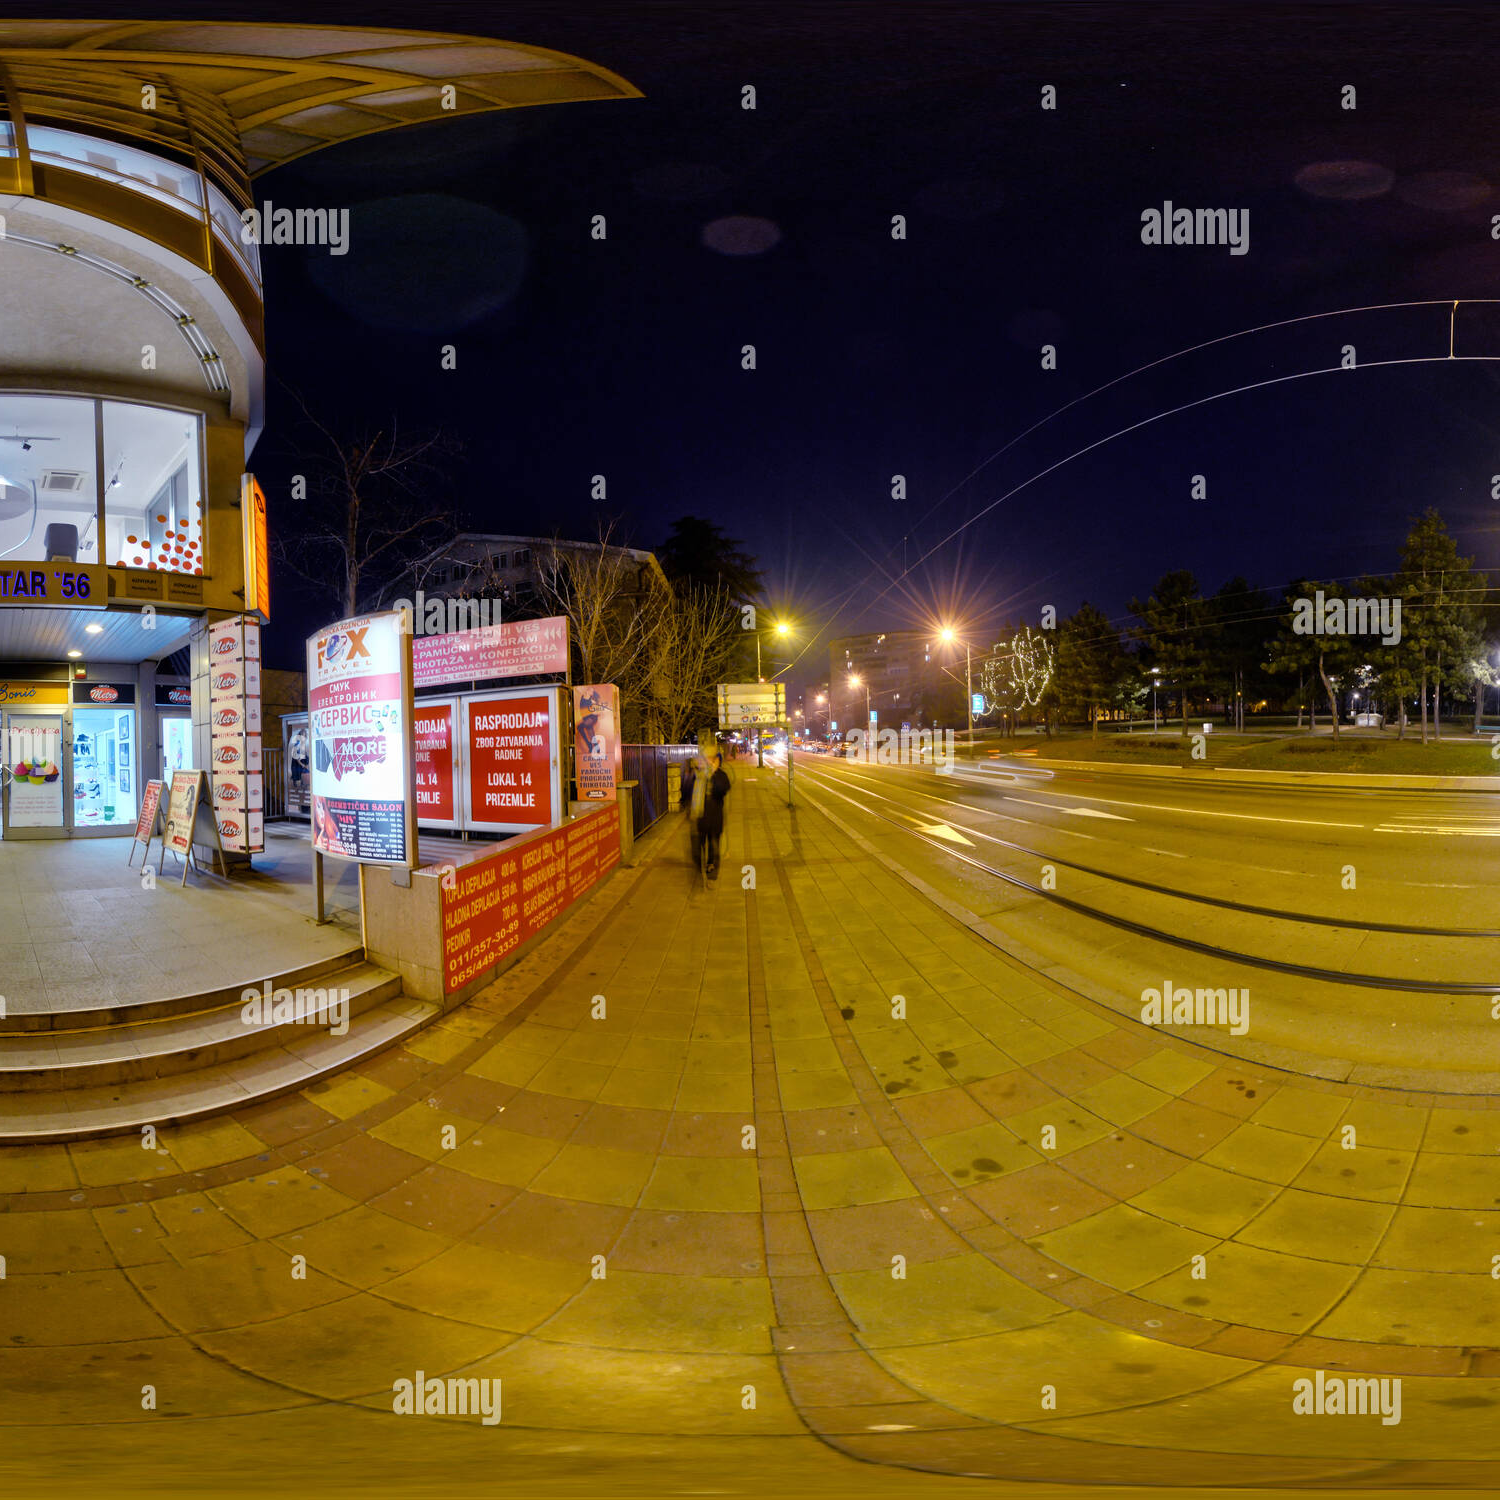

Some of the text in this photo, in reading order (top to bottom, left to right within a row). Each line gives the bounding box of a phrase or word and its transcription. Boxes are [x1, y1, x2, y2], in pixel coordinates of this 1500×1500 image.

[417, 634, 461, 650] ČARAPE
[516, 623, 541, 634] VEŠ
[212, 637, 238, 655] Metro
[419, 635, 539, 659] PAMUČNI PROGRAM
[413, 643, 558, 670] RIKOTAŽA KONFEKCIJA
[318, 660, 372, 677] TRAVEL
[213, 674, 239, 691] Metro
[330, 681, 350, 694] СМУК
[90, 689, 118, 700] Metro
[213, 711, 240, 727] Metro
[321, 705, 374, 728] СЕРВИС
[475, 712, 543, 731] RASPRODAJA
[12, 726, 60, 737] Principessa
[341, 739, 387, 755] MORE
[475, 734, 543, 748] ZBOG ZATVARANJA
[214, 748, 240, 764] Metro
[495, 749, 523, 760] RADNJE
[428, 772, 438, 785] 14
[488, 772, 532, 786] LOKAL 14
[214, 785, 241, 802] Metro
[486, 793, 535, 807] PRIZEMLJE
[372, 802, 402, 812] SALON
[465, 866, 496, 897] DEPILACIJA
[445, 904, 471, 931] HLADNA
[471, 889, 500, 918] DEPILACIJA
[446, 927, 471, 955] PEDIKIR
[449, 920, 519, 971] 011/357-30-89
[450, 933, 519, 988] 065/449-3333
